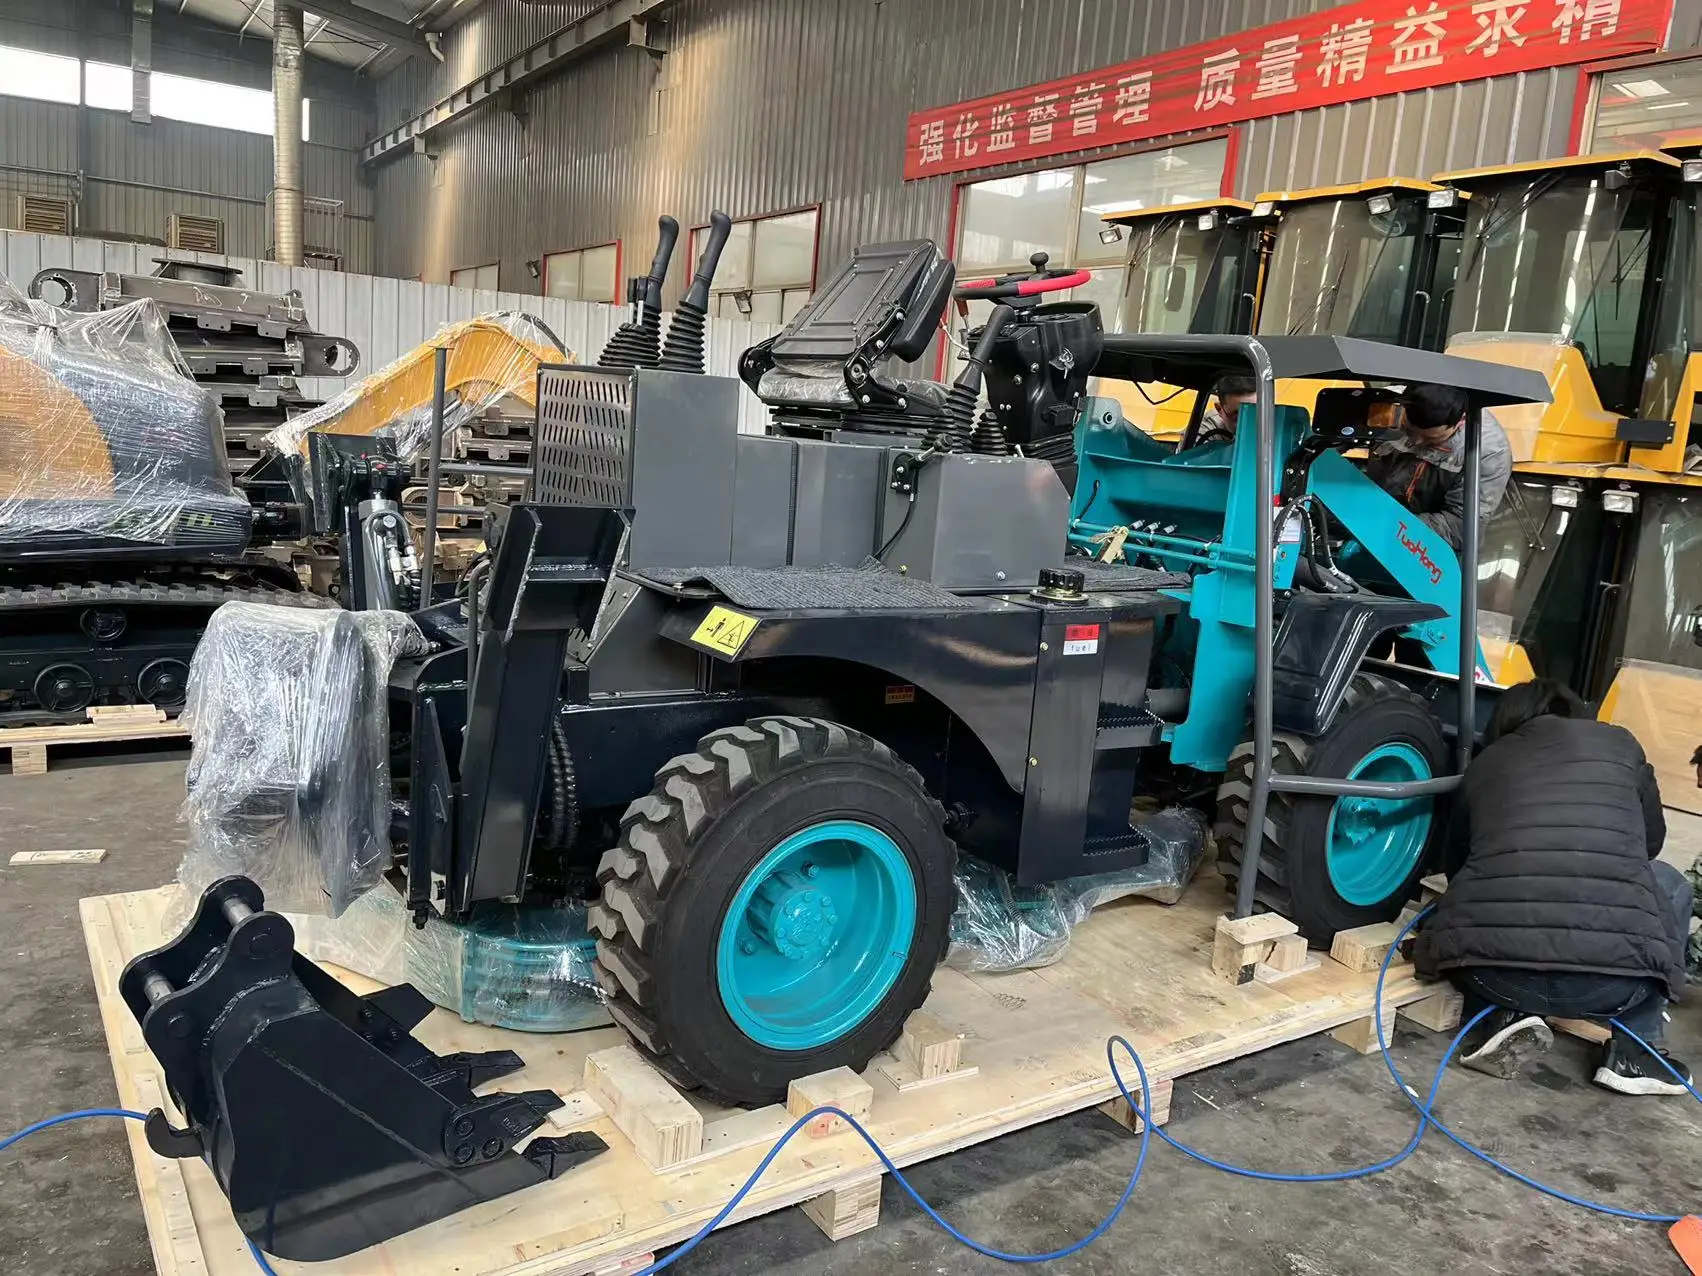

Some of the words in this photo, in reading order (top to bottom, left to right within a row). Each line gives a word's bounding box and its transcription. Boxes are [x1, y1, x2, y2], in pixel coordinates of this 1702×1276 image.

[919, 70, 1153, 166] 强化监督管理
[1192, 0, 1623, 113] 质量精益求精
